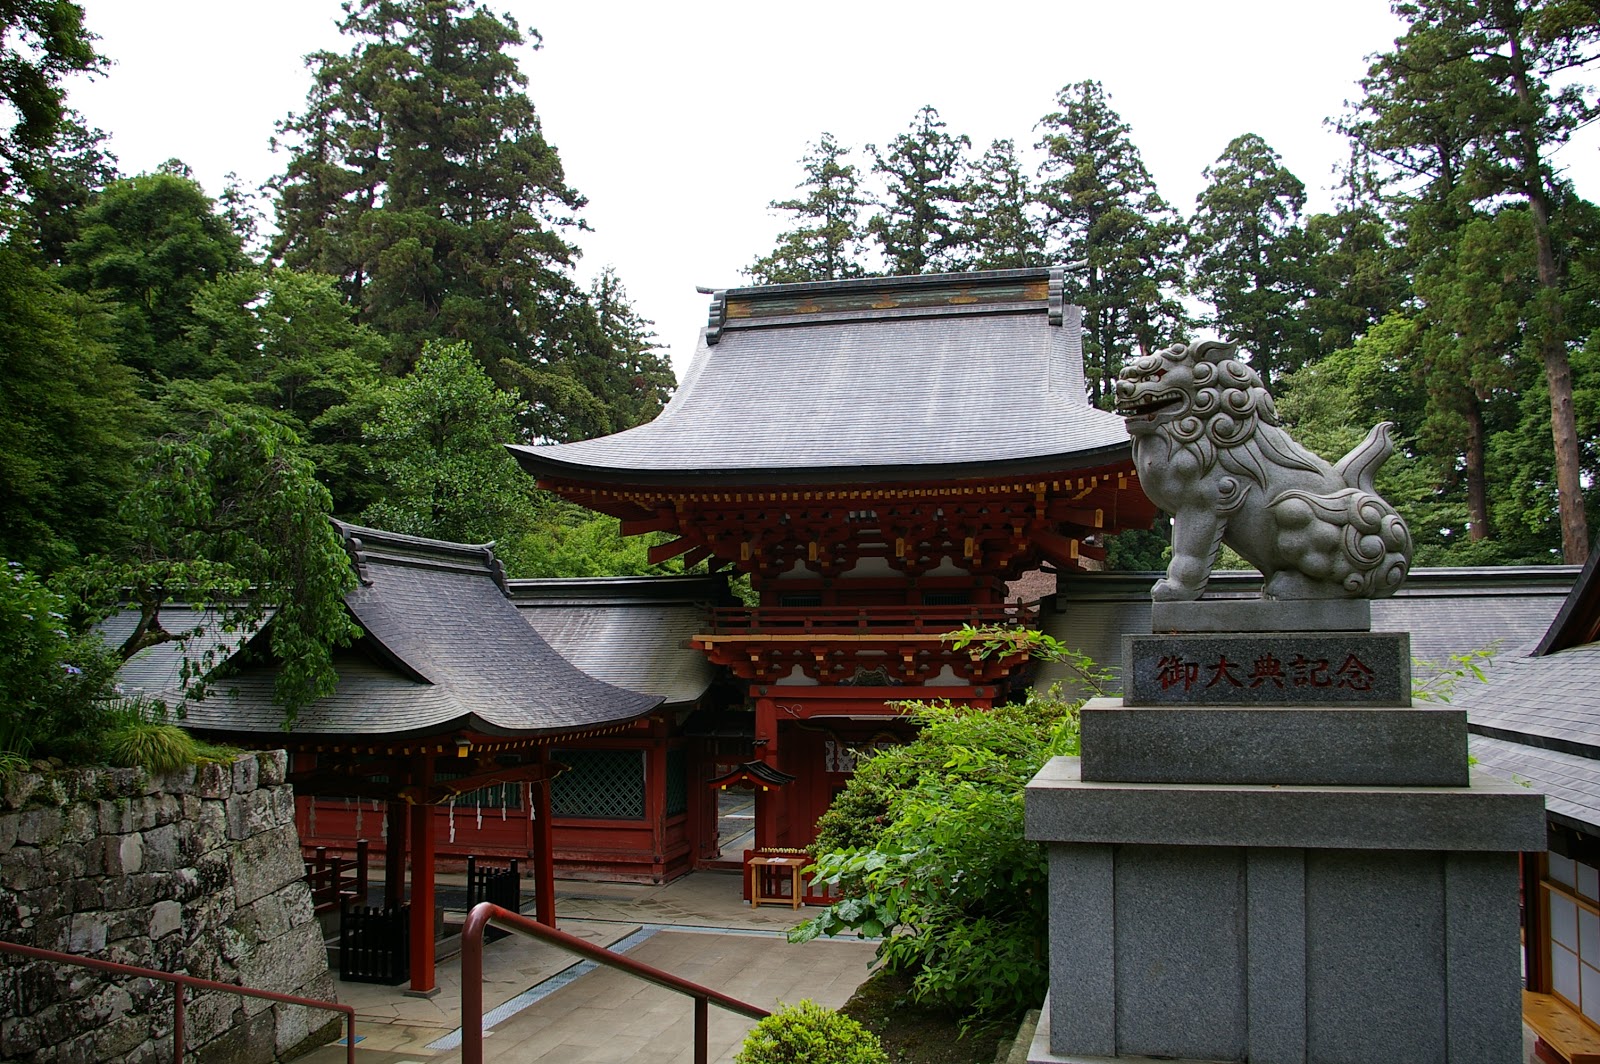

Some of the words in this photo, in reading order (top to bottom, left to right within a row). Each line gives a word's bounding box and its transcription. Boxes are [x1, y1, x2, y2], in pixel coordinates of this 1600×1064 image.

[1156, 653, 1374, 692] 御大典記念
